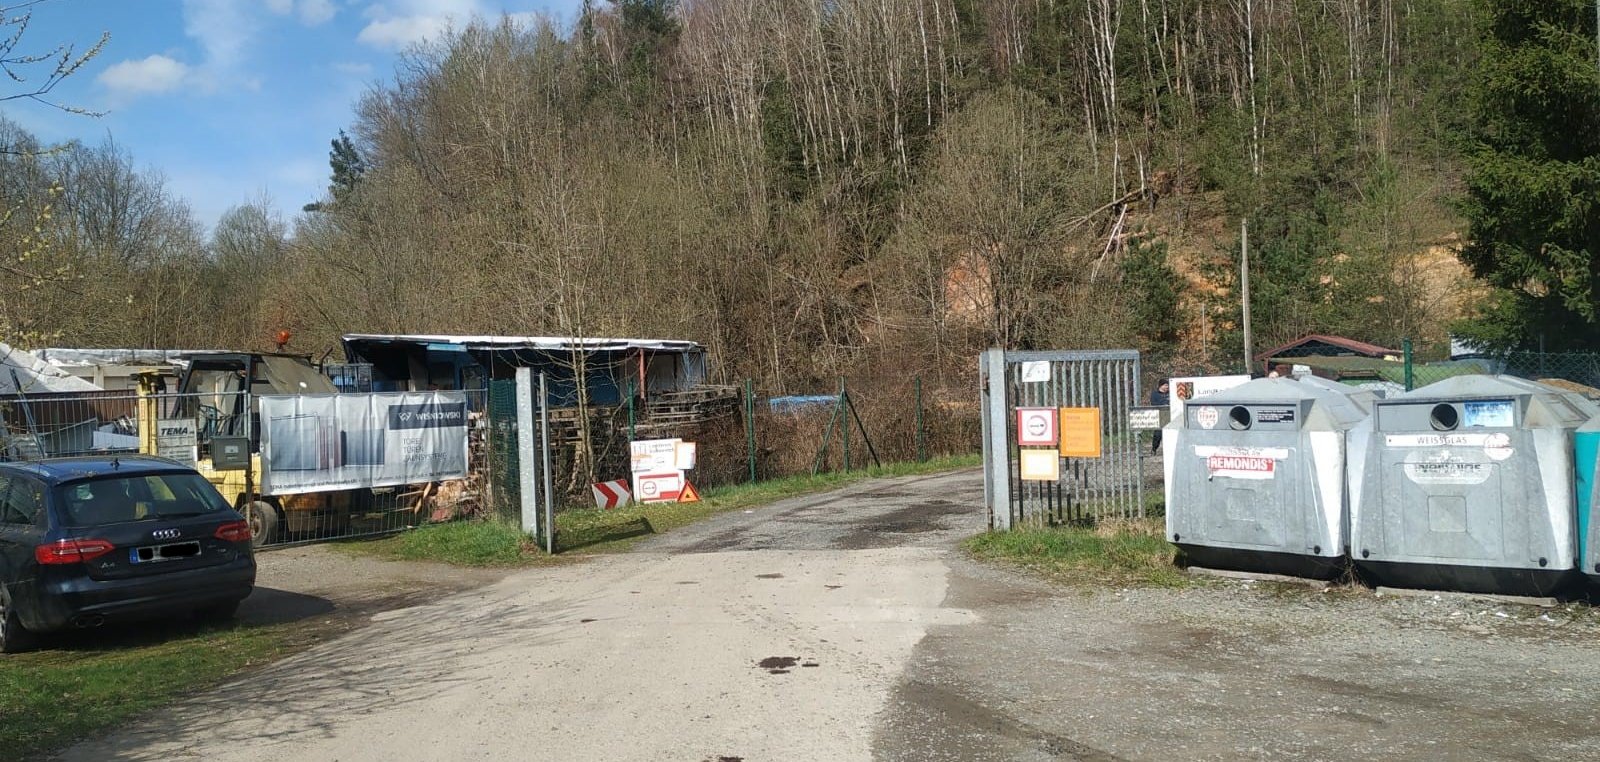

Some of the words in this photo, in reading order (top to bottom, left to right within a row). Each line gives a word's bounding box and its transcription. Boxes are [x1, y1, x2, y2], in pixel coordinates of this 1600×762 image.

[160, 427, 188, 436] TEMA
[1416, 436, 1468, 445] WEISSGLAS
[1210, 457, 1268, 470] REMONDIS
